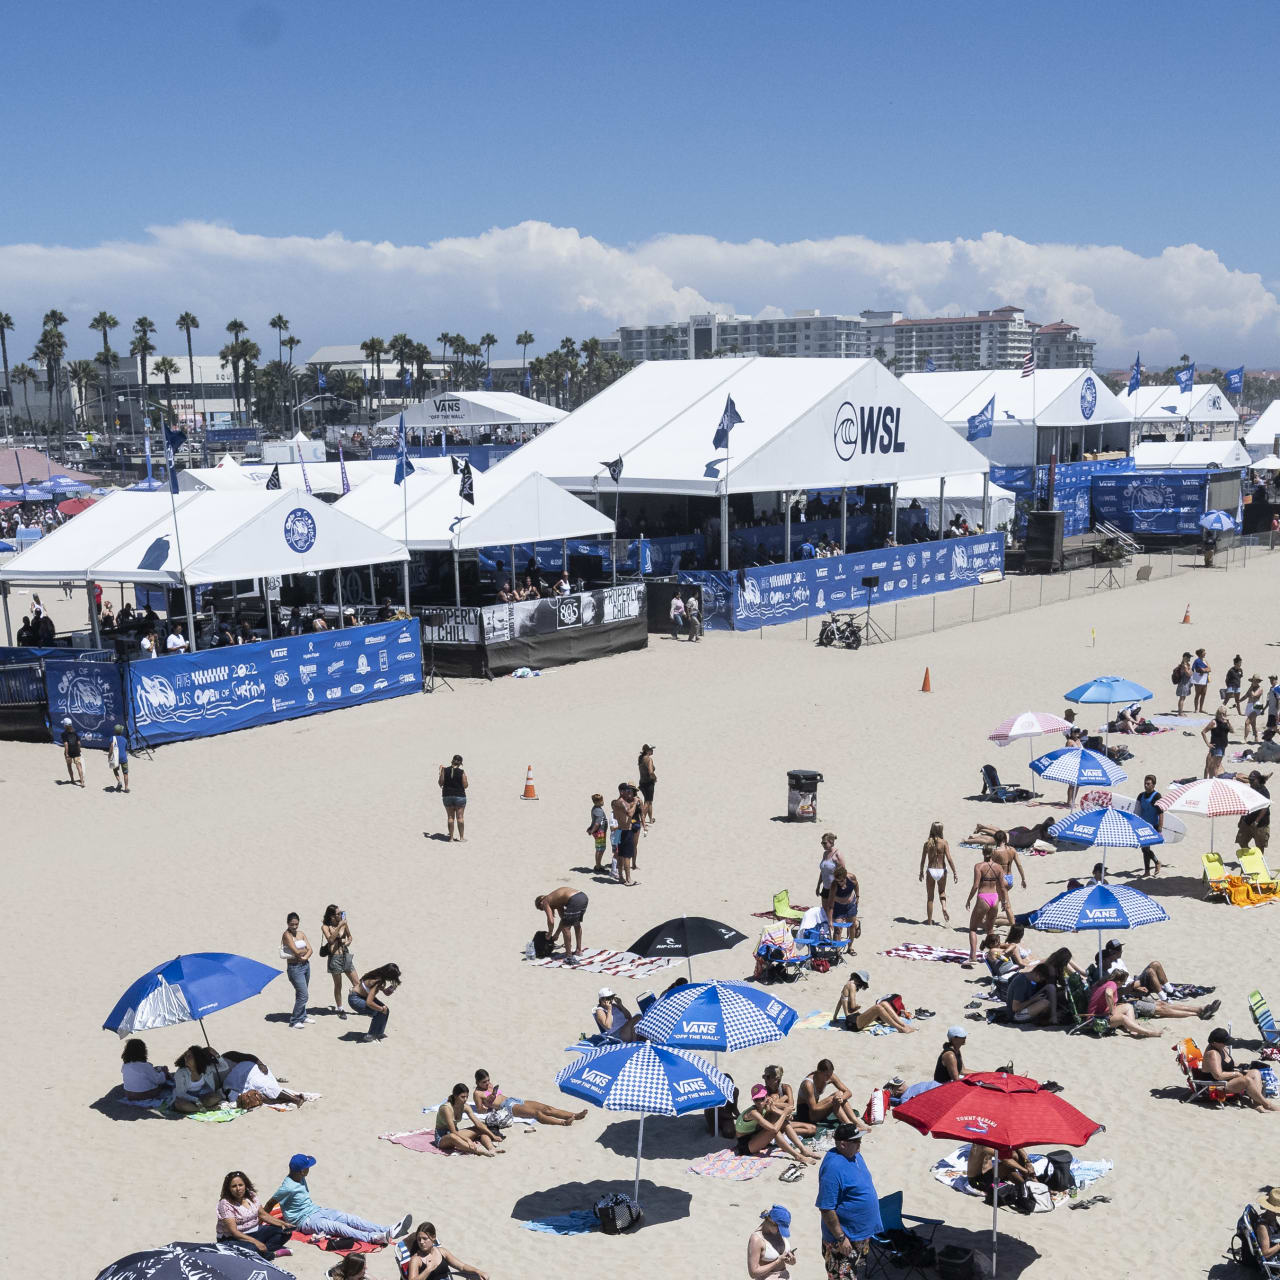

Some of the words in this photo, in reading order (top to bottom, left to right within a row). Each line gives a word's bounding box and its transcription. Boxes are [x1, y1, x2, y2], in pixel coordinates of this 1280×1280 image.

[859, 405, 906, 455] WSL
[559, 602, 579, 621] 805
[437, 625, 471, 642] CHILL
[229, 662, 260, 678] 2022
[1086, 908, 1118, 919] VANS
[682, 1020, 718, 1035] VANS
[581, 1067, 613, 1088] VANS
[672, 1077, 707, 1094] VANS
